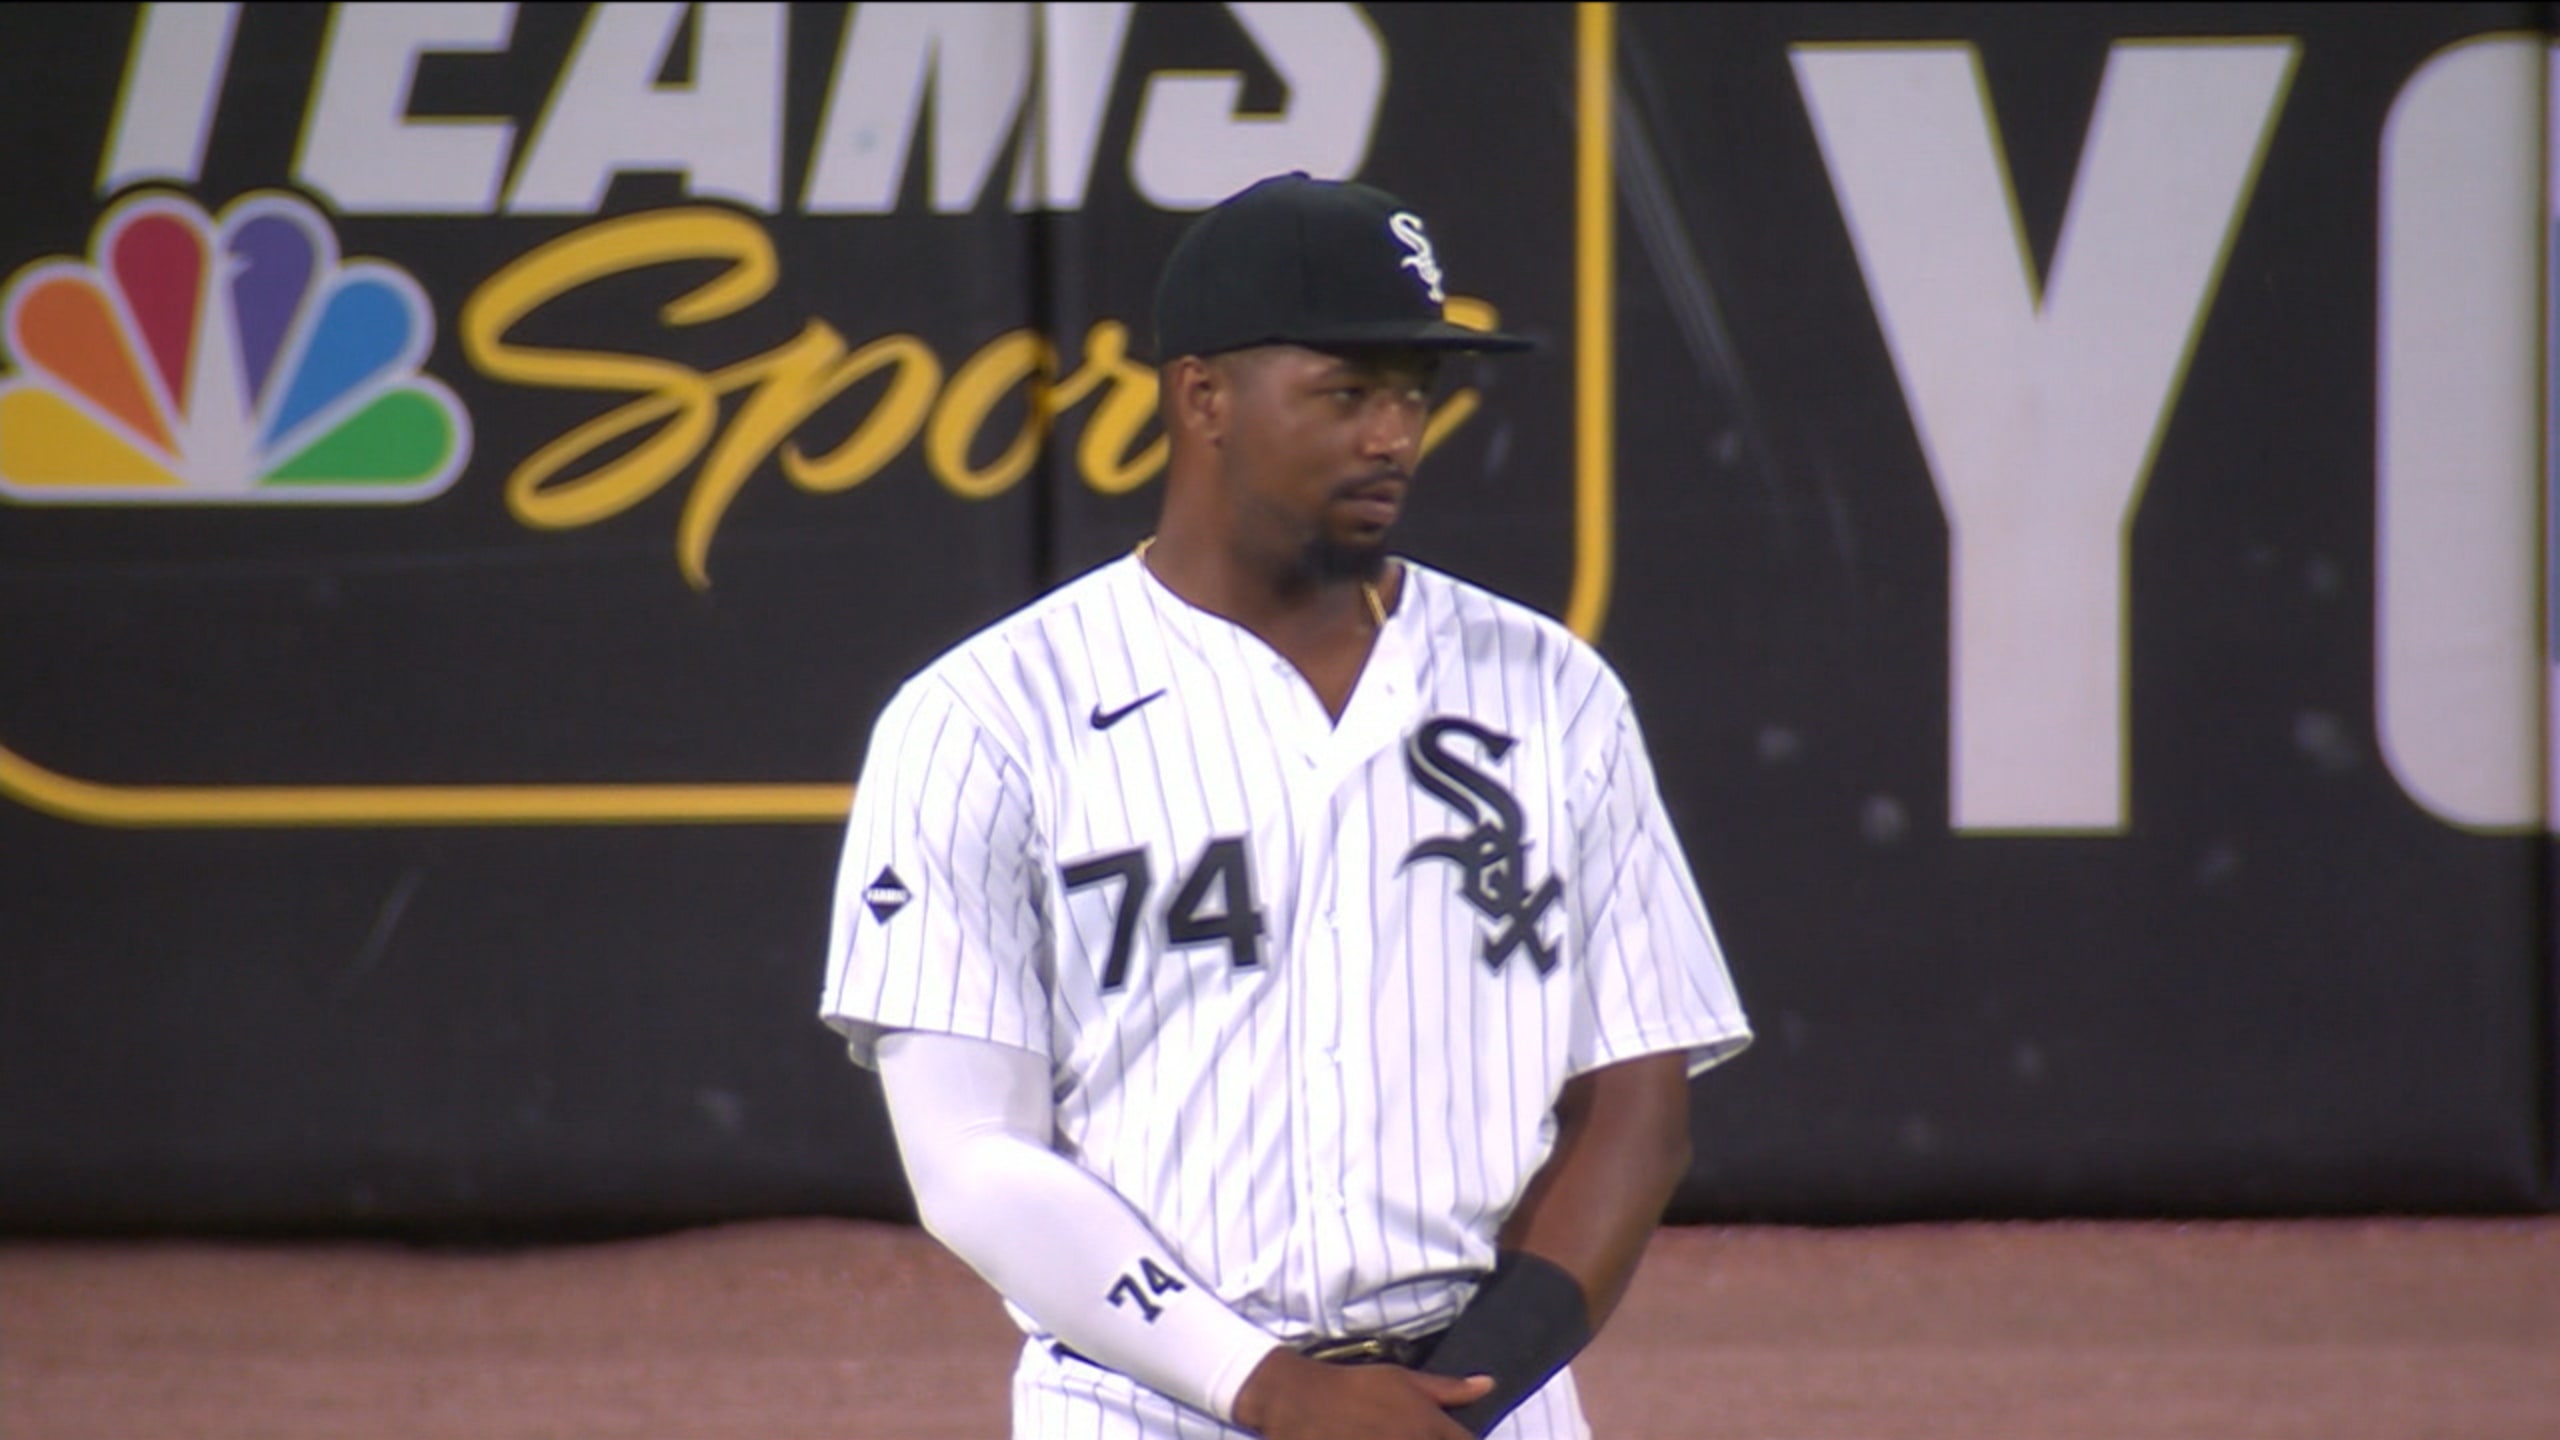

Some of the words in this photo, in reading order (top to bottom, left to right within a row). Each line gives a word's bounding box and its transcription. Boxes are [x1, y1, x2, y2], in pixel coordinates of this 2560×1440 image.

[1058, 835, 1271, 996] 74
[1394, 715, 1564, 980] Sox
[1106, 1257, 1186, 1324] 74
